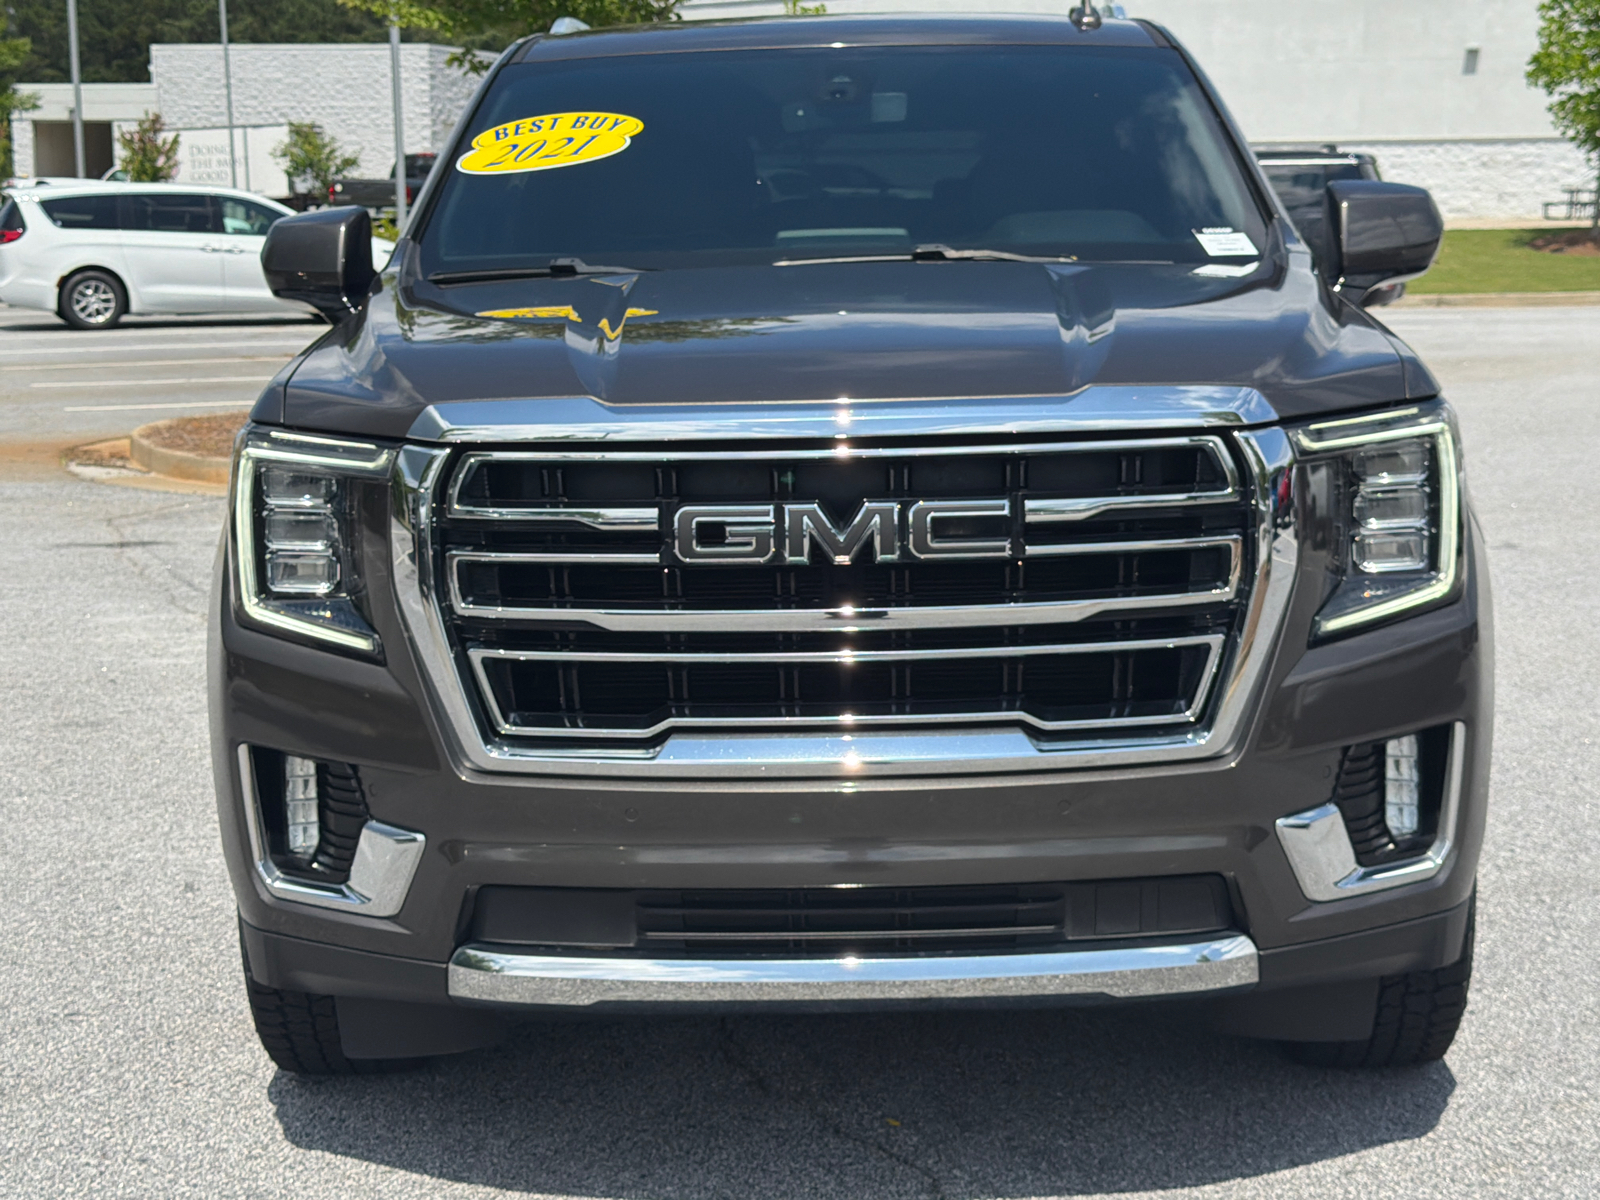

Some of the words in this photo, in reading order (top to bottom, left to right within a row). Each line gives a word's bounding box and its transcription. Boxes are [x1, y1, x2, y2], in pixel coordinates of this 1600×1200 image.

[494, 117, 564, 142] BEST
[570, 115, 628, 132] BUY
[482, 134, 601, 168] 2021
[673, 499, 1011, 565] GMC
